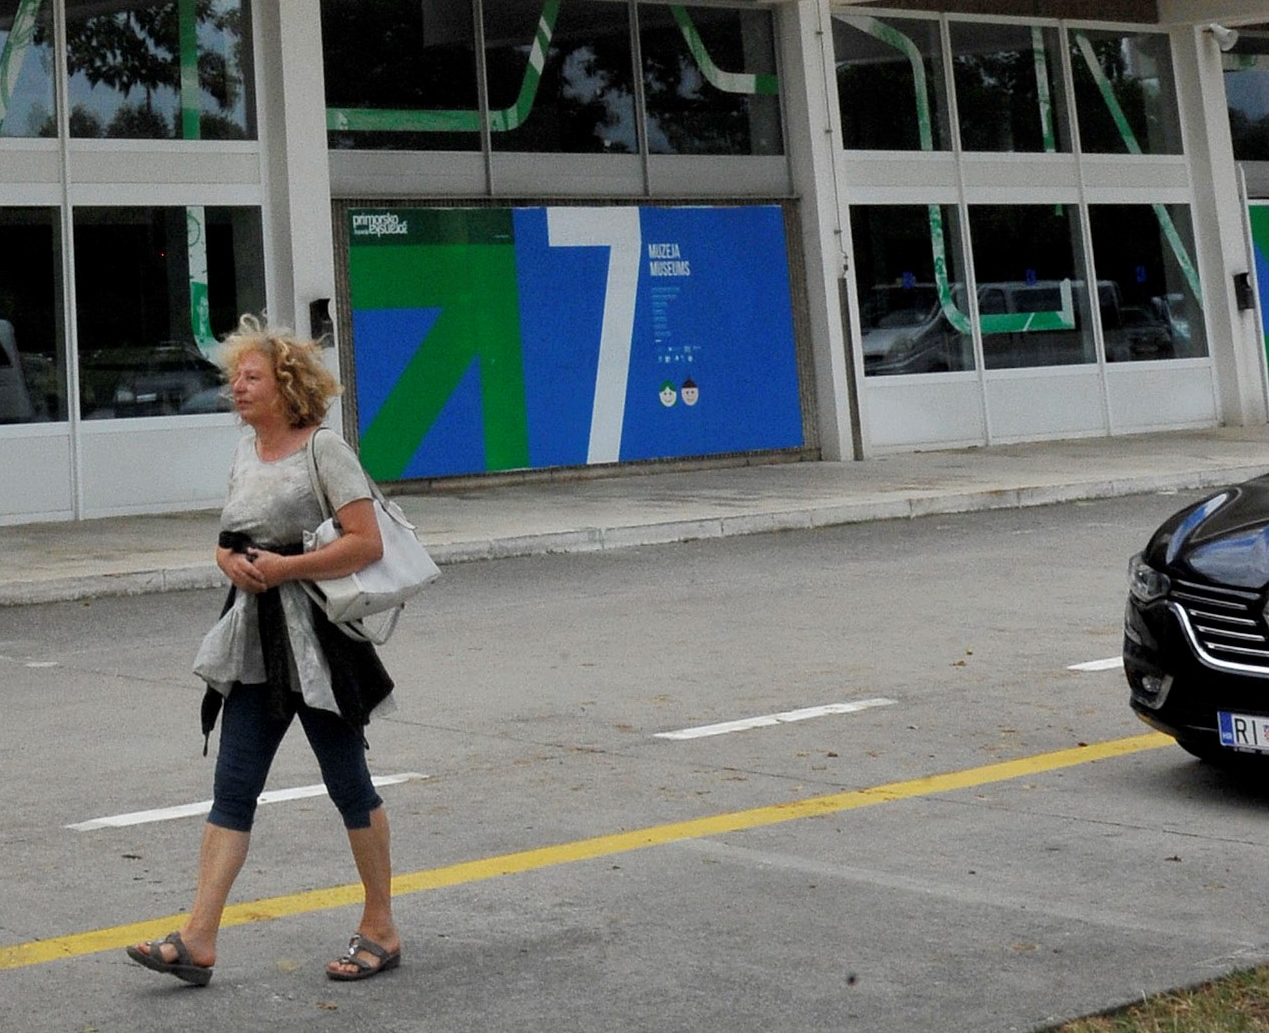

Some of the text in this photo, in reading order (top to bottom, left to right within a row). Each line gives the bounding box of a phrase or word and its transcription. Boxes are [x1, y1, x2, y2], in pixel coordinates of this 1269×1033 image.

[648, 243, 681, 259] MUZEJA
[650, 261, 691, 276] MUSEUMS
[546, 206, 642, 465] 7
[1234, 718, 1258, 745] RI
